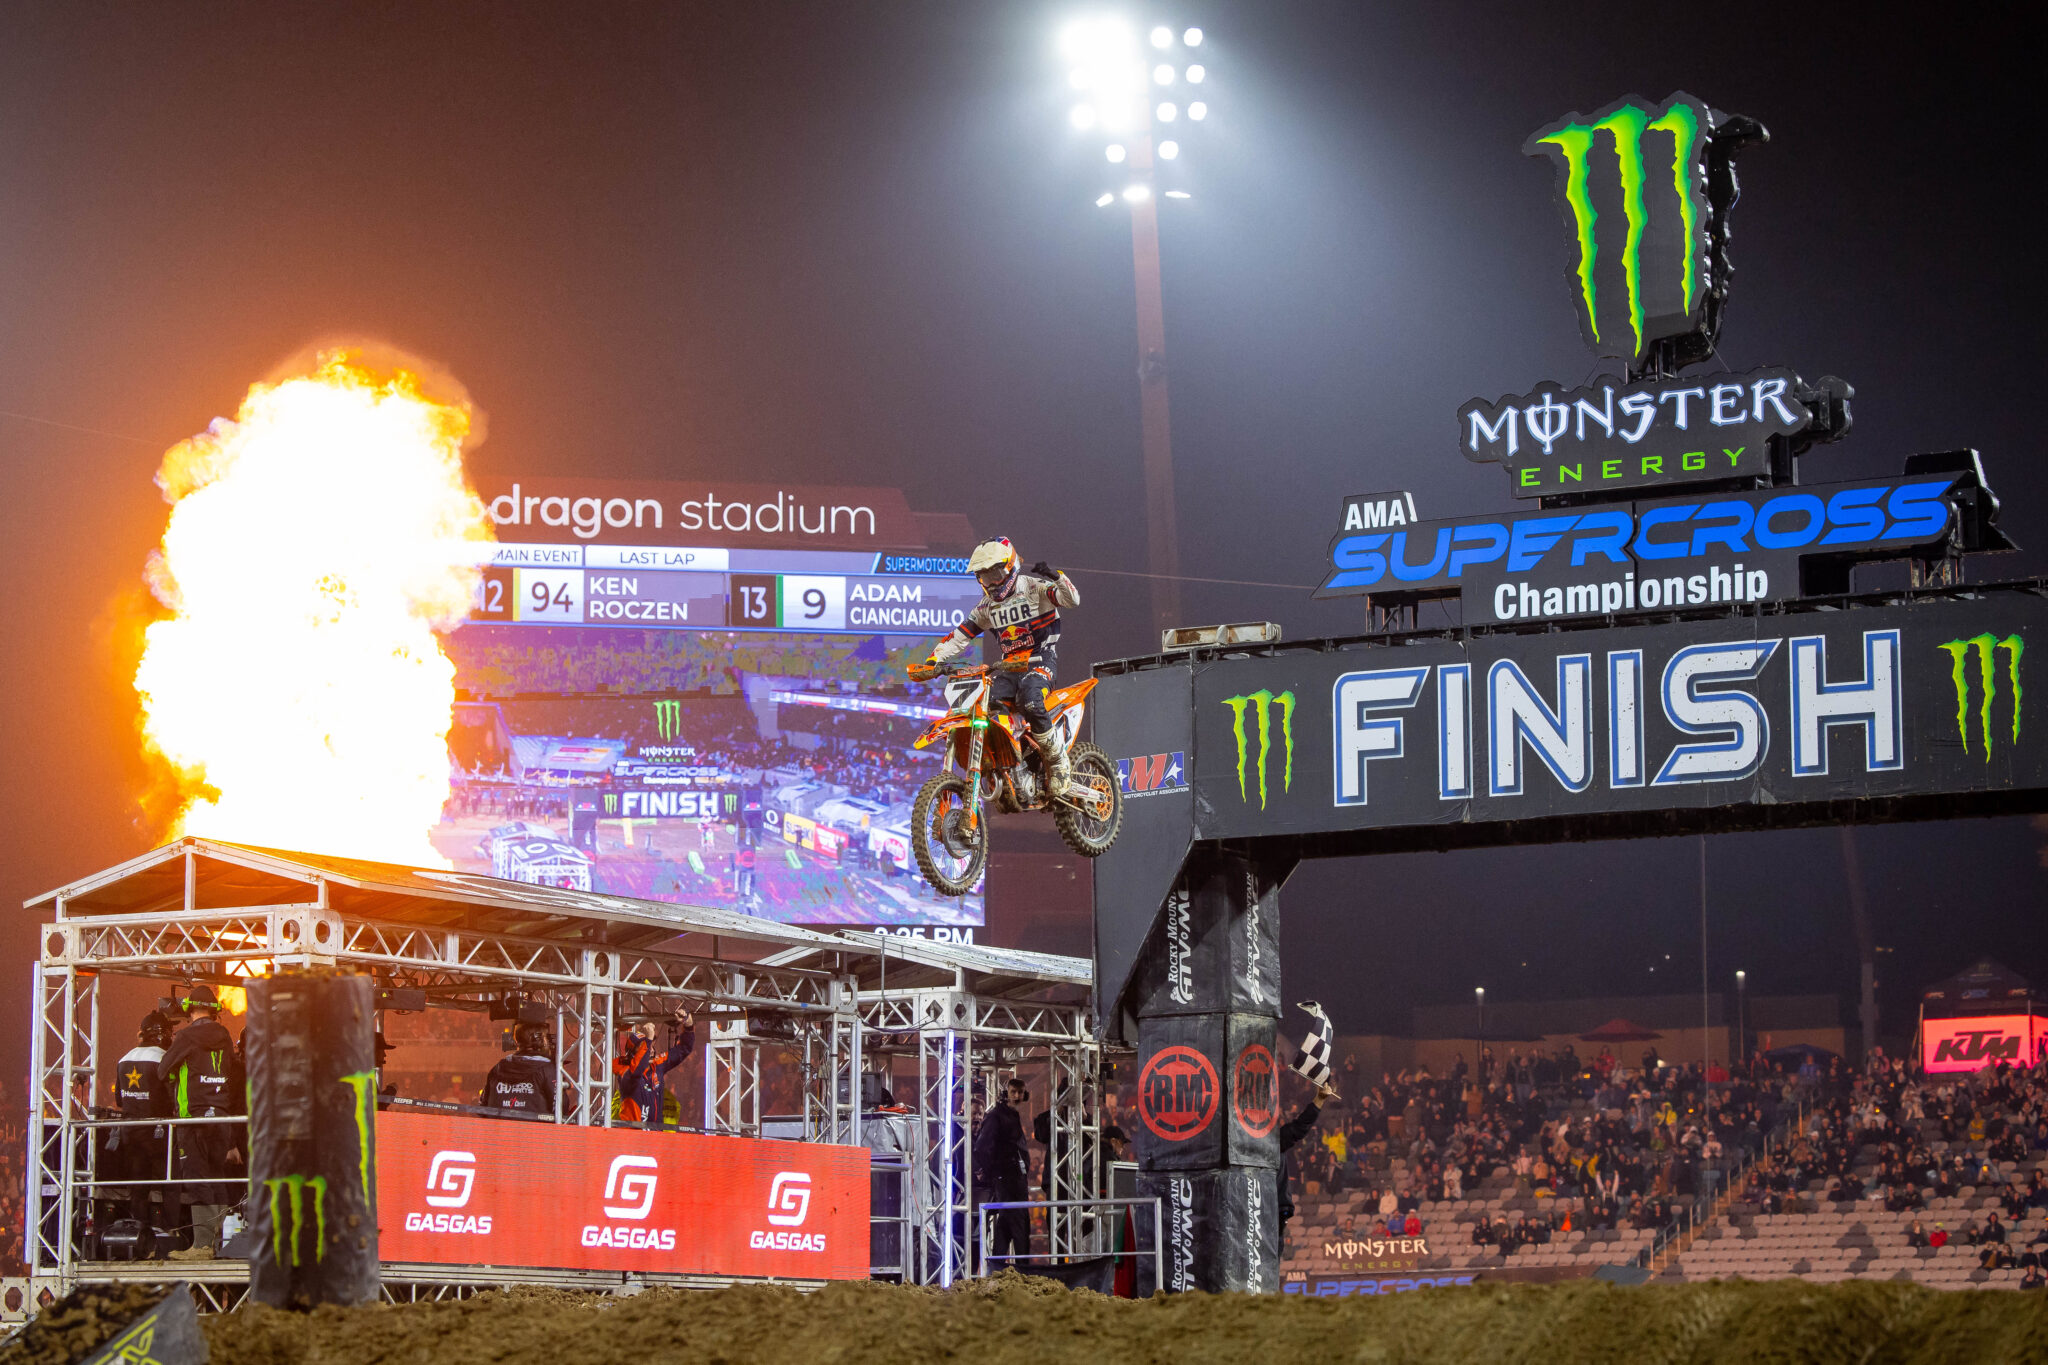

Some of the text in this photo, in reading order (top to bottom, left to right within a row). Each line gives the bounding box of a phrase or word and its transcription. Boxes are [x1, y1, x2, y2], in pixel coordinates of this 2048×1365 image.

[1467, 377, 1799, 456] MONSTER
[1520, 446, 1746, 487] ENERGY
[680, 492, 876, 535] stadium
[1344, 492, 1418, 531] AMA
[1326, 481, 1955, 588] SUPERCROSS
[533, 550, 579, 562] EVENT
[620, 552, 696, 565] LAST LAP
[531, 581, 574, 613] 94
[589, 577, 639, 596] KEN
[850, 583, 922, 603] ADAM
[1494, 564, 1769, 619] Championship
[589, 600, 689, 621] ROCZEN
[739, 586, 767, 619] 13
[803, 588, 827, 619] 9
[850, 606, 965, 627] CIANCIARULO
[991, 603, 1032, 627] THOR
[951, 681, 981, 709] 7
[1333, 628, 1904, 808] FINISH
[622, 791, 719, 816] FINISH
[1124, 786, 1189, 799] MOTORCYCLIST ASSOCIATION
[1167, 891, 1178, 983] ROCKY MOUNT
[1246, 941, 1254, 983] ROCKY
[1933, 1030, 2021, 1063] KTM
[1154, 1075, 1203, 1112] RM
[405, 1212, 492, 1234] GASGAS
[581, 1225, 676, 1250] GASGAS
[1170, 1178, 1183, 1290] ROCKY MOUNTAIN
[1246, 1177, 1255, 1290] ROCKY MOUNTAIN
[750, 1230, 826, 1252] GASGAS
[1325, 1238, 1428, 1259] MONSTER
[1286, 1271, 1307, 1282] AMA
[1342, 1261, 1413, 1270] ENERGY
